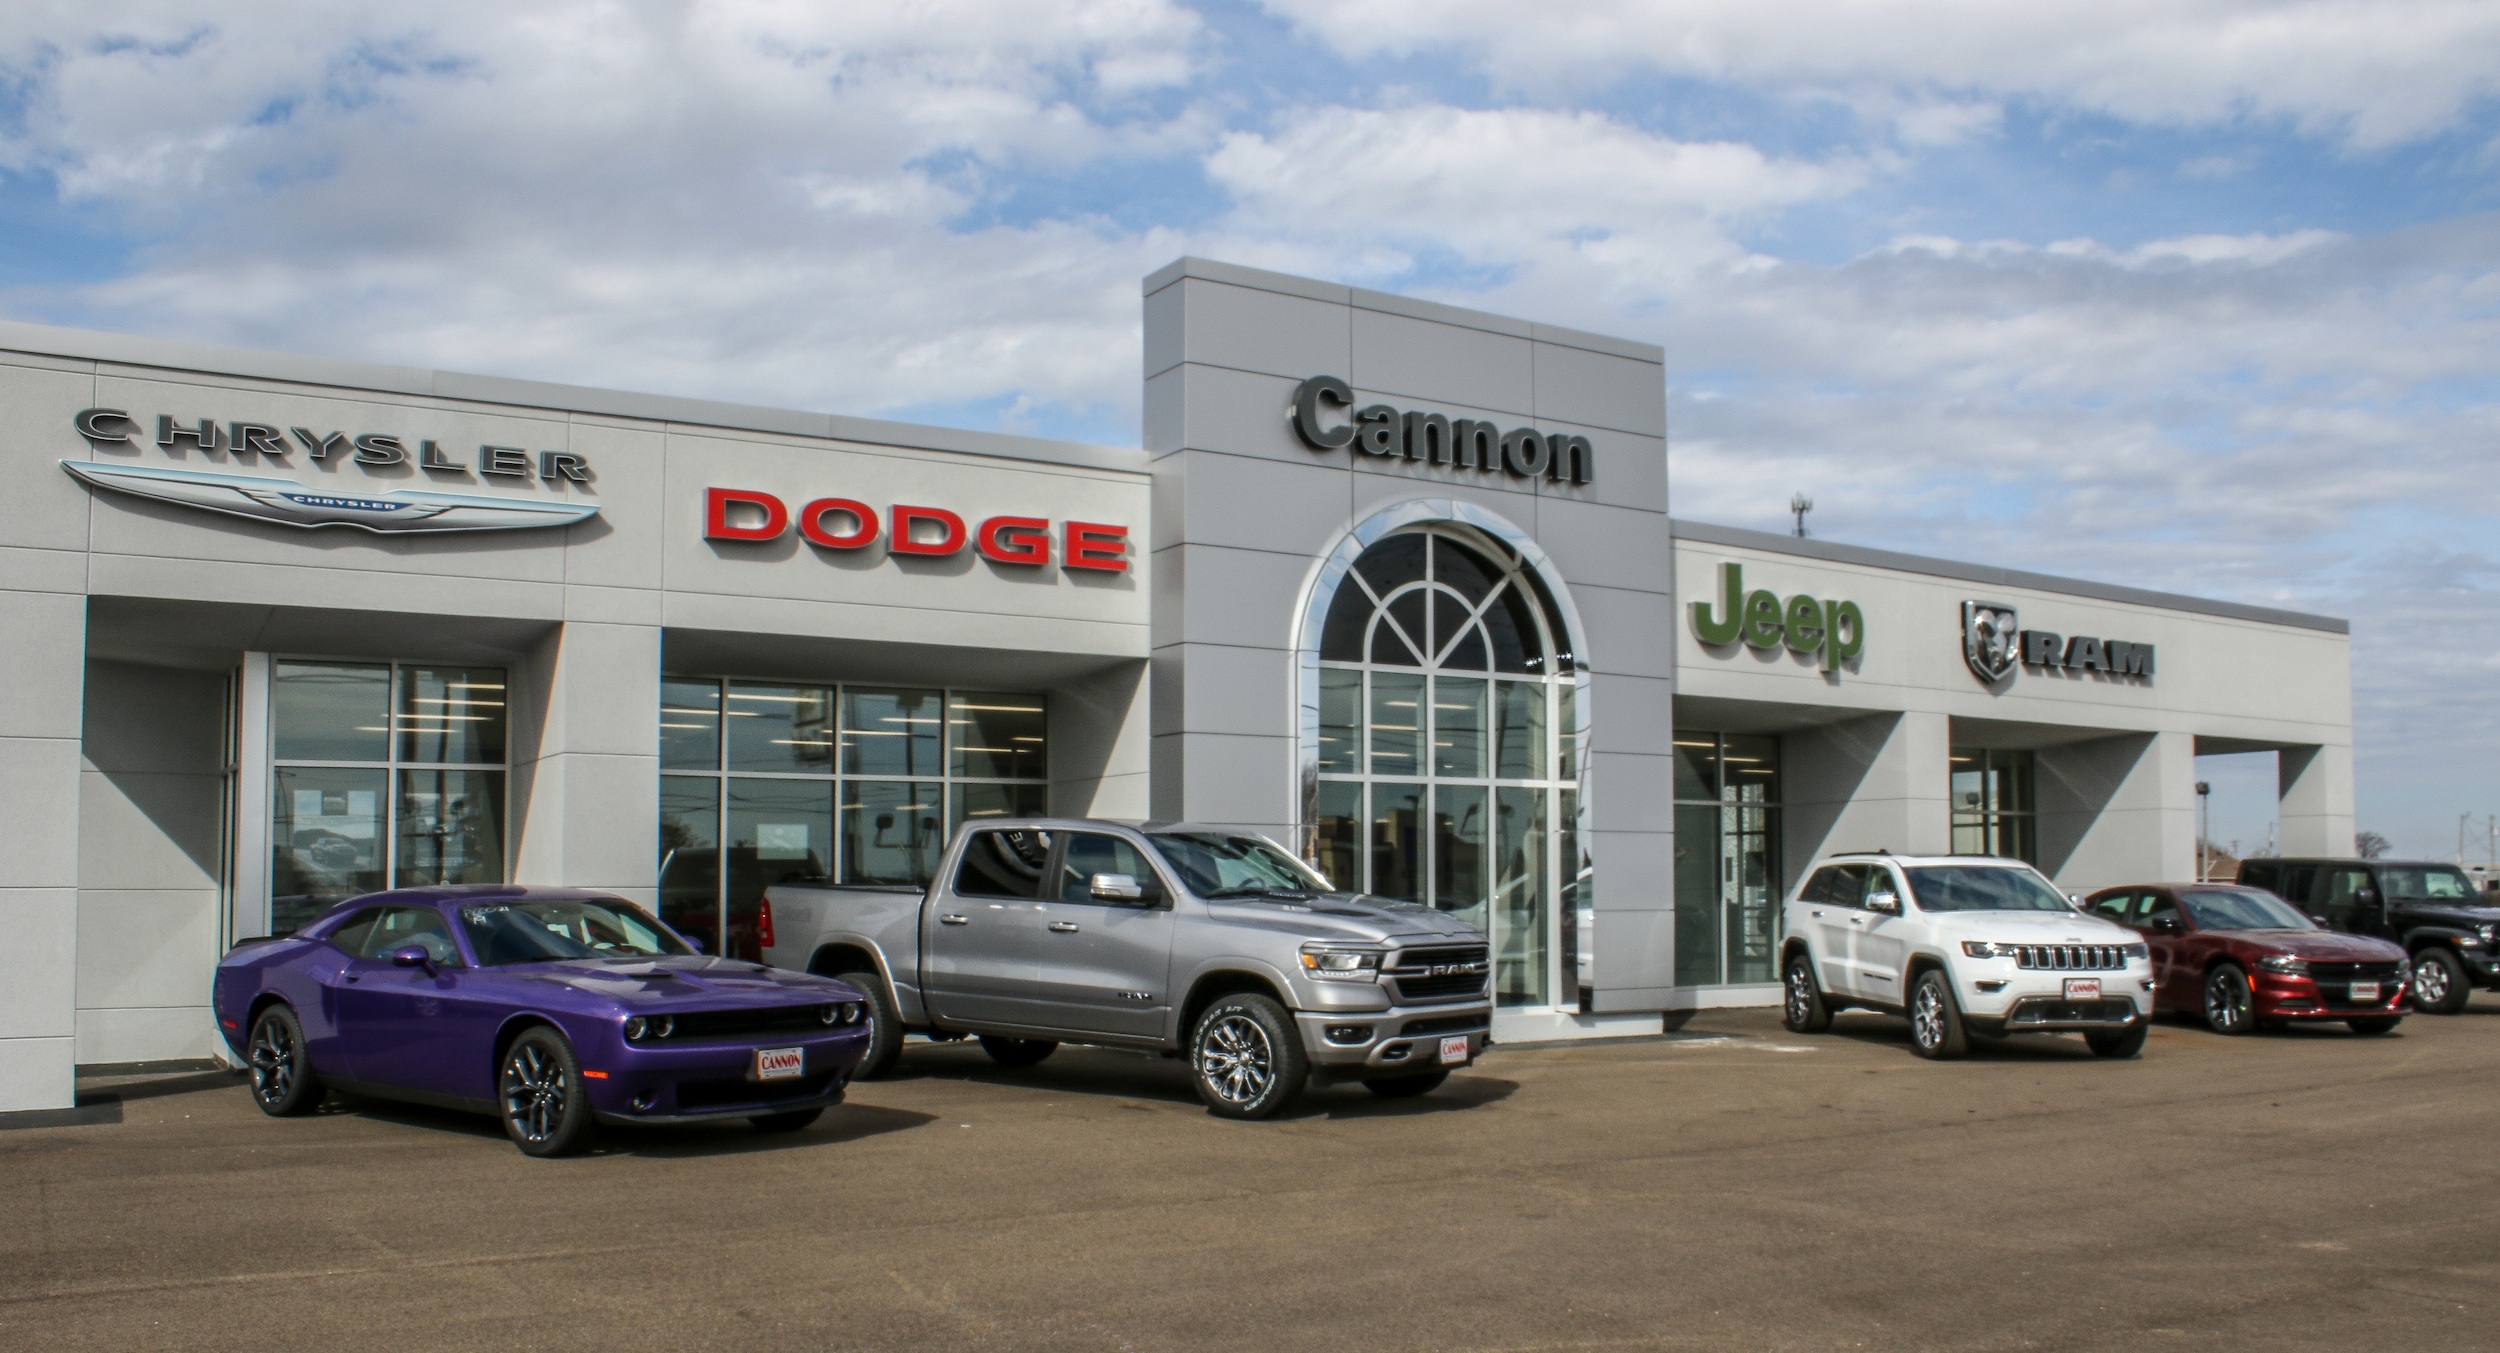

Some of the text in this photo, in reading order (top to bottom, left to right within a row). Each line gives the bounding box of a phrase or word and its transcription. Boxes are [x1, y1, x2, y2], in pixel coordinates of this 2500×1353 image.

[73, 408, 590, 482] CHRYSLER
[1292, 375, 1594, 485] Cannon
[293, 496, 396, 510] CHRYSLER
[703, 487, 1129, 572] DODGE
[1689, 562, 1864, 671] Jeep
[2020, 629, 2155, 675] RAM
[1432, 963, 1475, 976] RAM
[761, 1054, 801, 1070] CANNON
